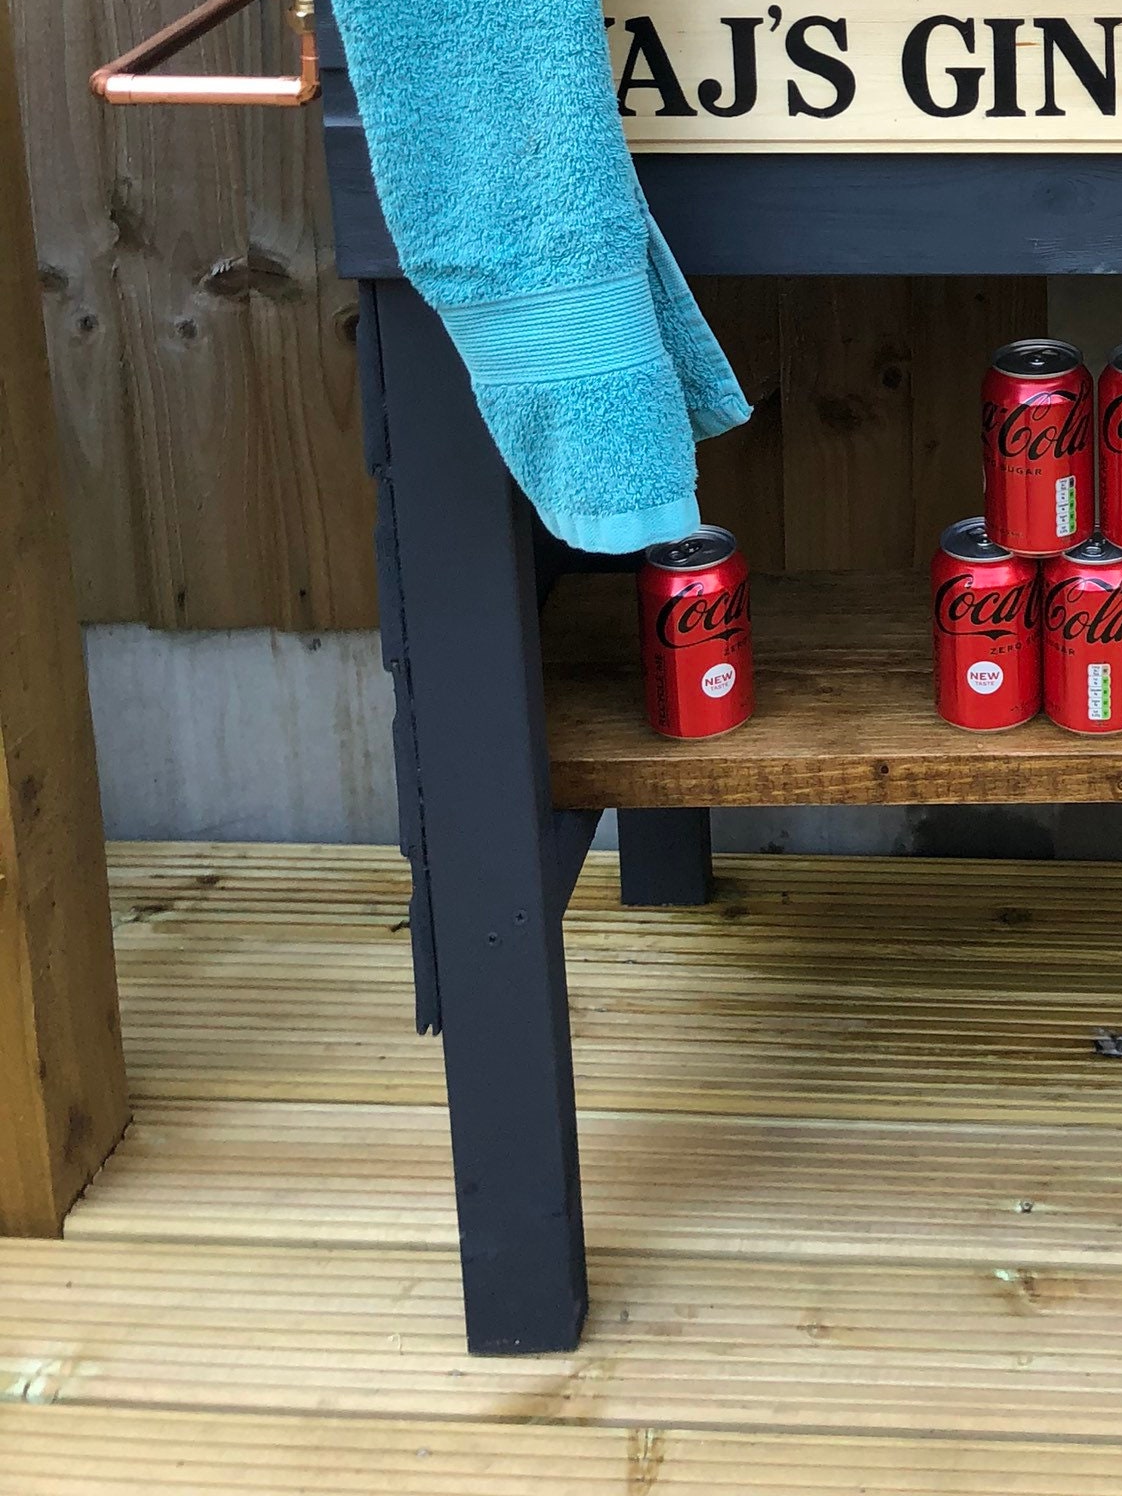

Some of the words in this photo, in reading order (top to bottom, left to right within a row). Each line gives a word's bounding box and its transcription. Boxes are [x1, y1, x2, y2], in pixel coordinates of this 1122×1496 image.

[604, 4, 857, 120] AJ'S
[900, 13, 1122, 118] GIN
[990, 642, 1022, 655] ZERO
[705, 671, 733, 687] NEW
[970, 671, 1000, 681] NEW
[710, 682, 729, 692] TASTE
